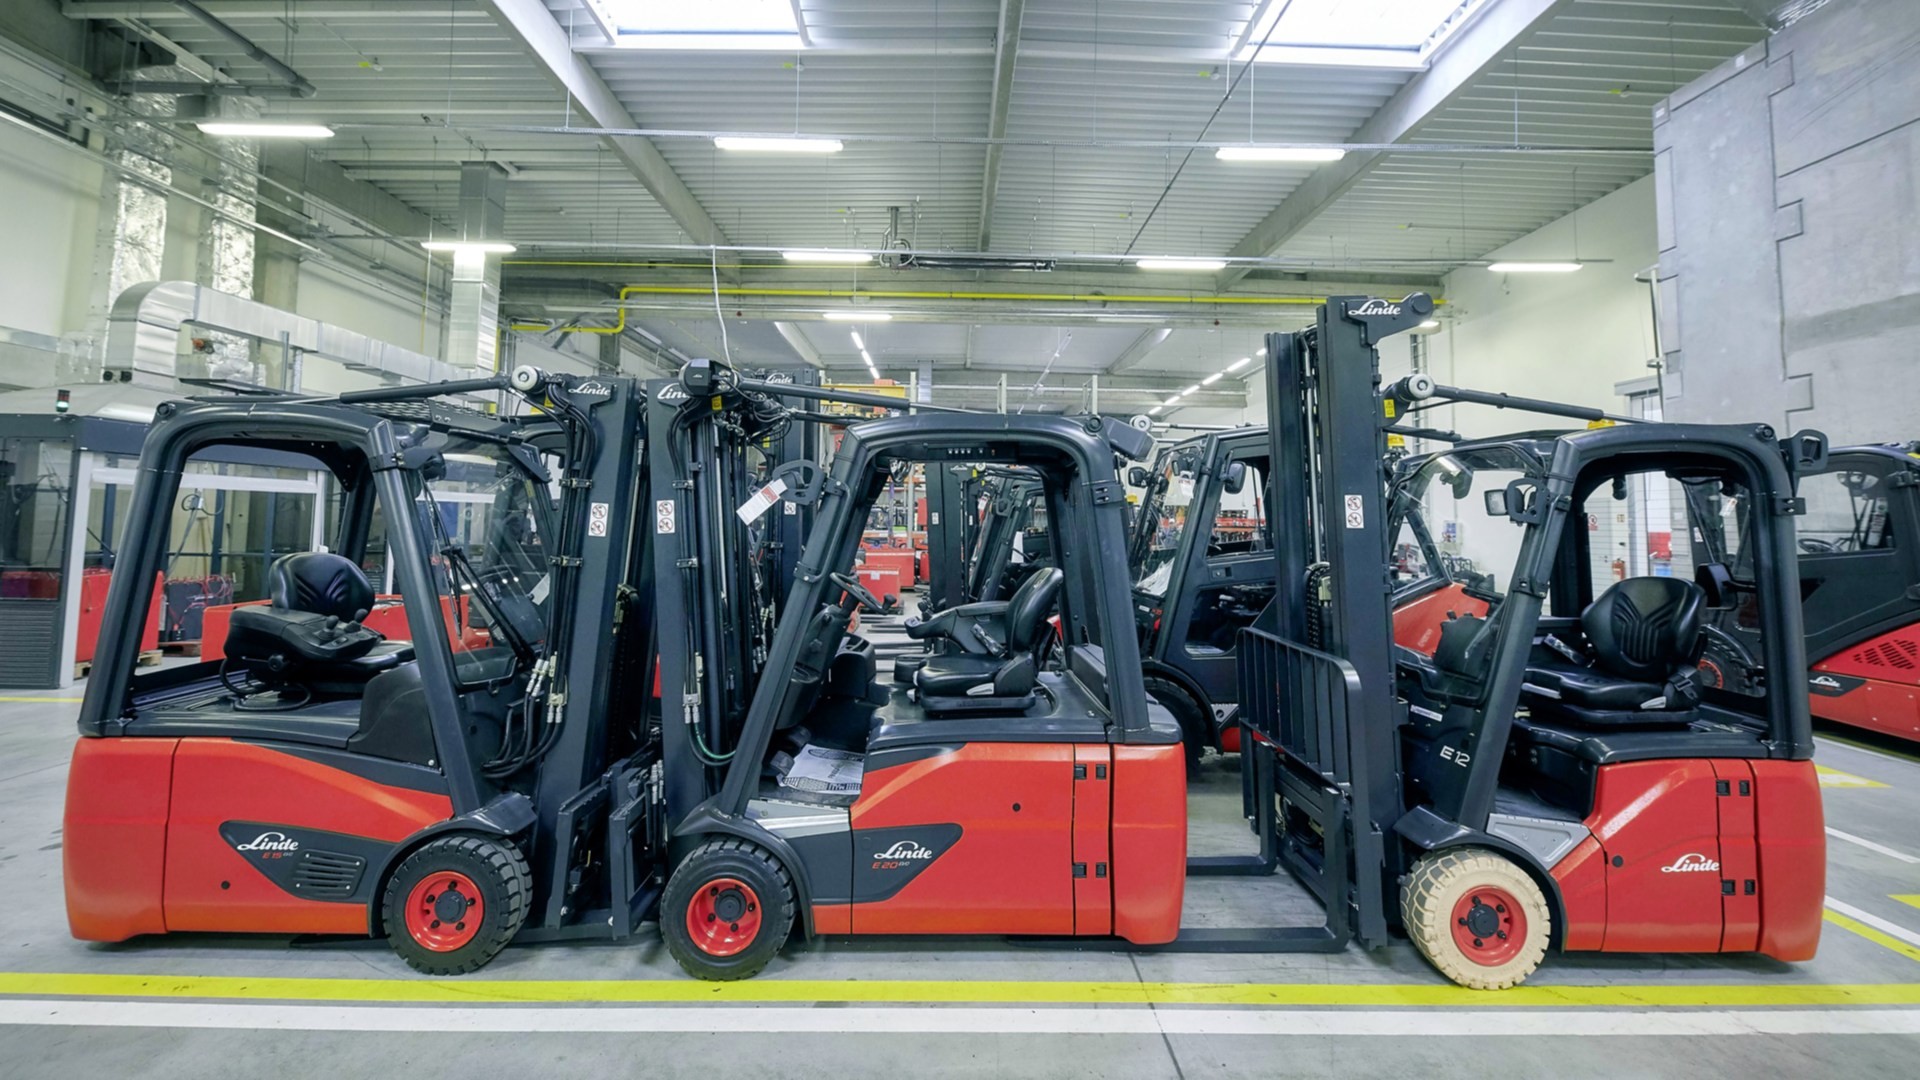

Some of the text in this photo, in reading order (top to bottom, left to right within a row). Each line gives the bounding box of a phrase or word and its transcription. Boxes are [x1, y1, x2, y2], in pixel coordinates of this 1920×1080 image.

[1348, 299, 1401, 315] Linde
[568, 380, 611, 396] Linde
[657, 382, 690, 399] Lin
[237, 831, 299, 850] Linde
[873, 840, 932, 859] Linde
[1661, 853, 1720, 872] Linde
